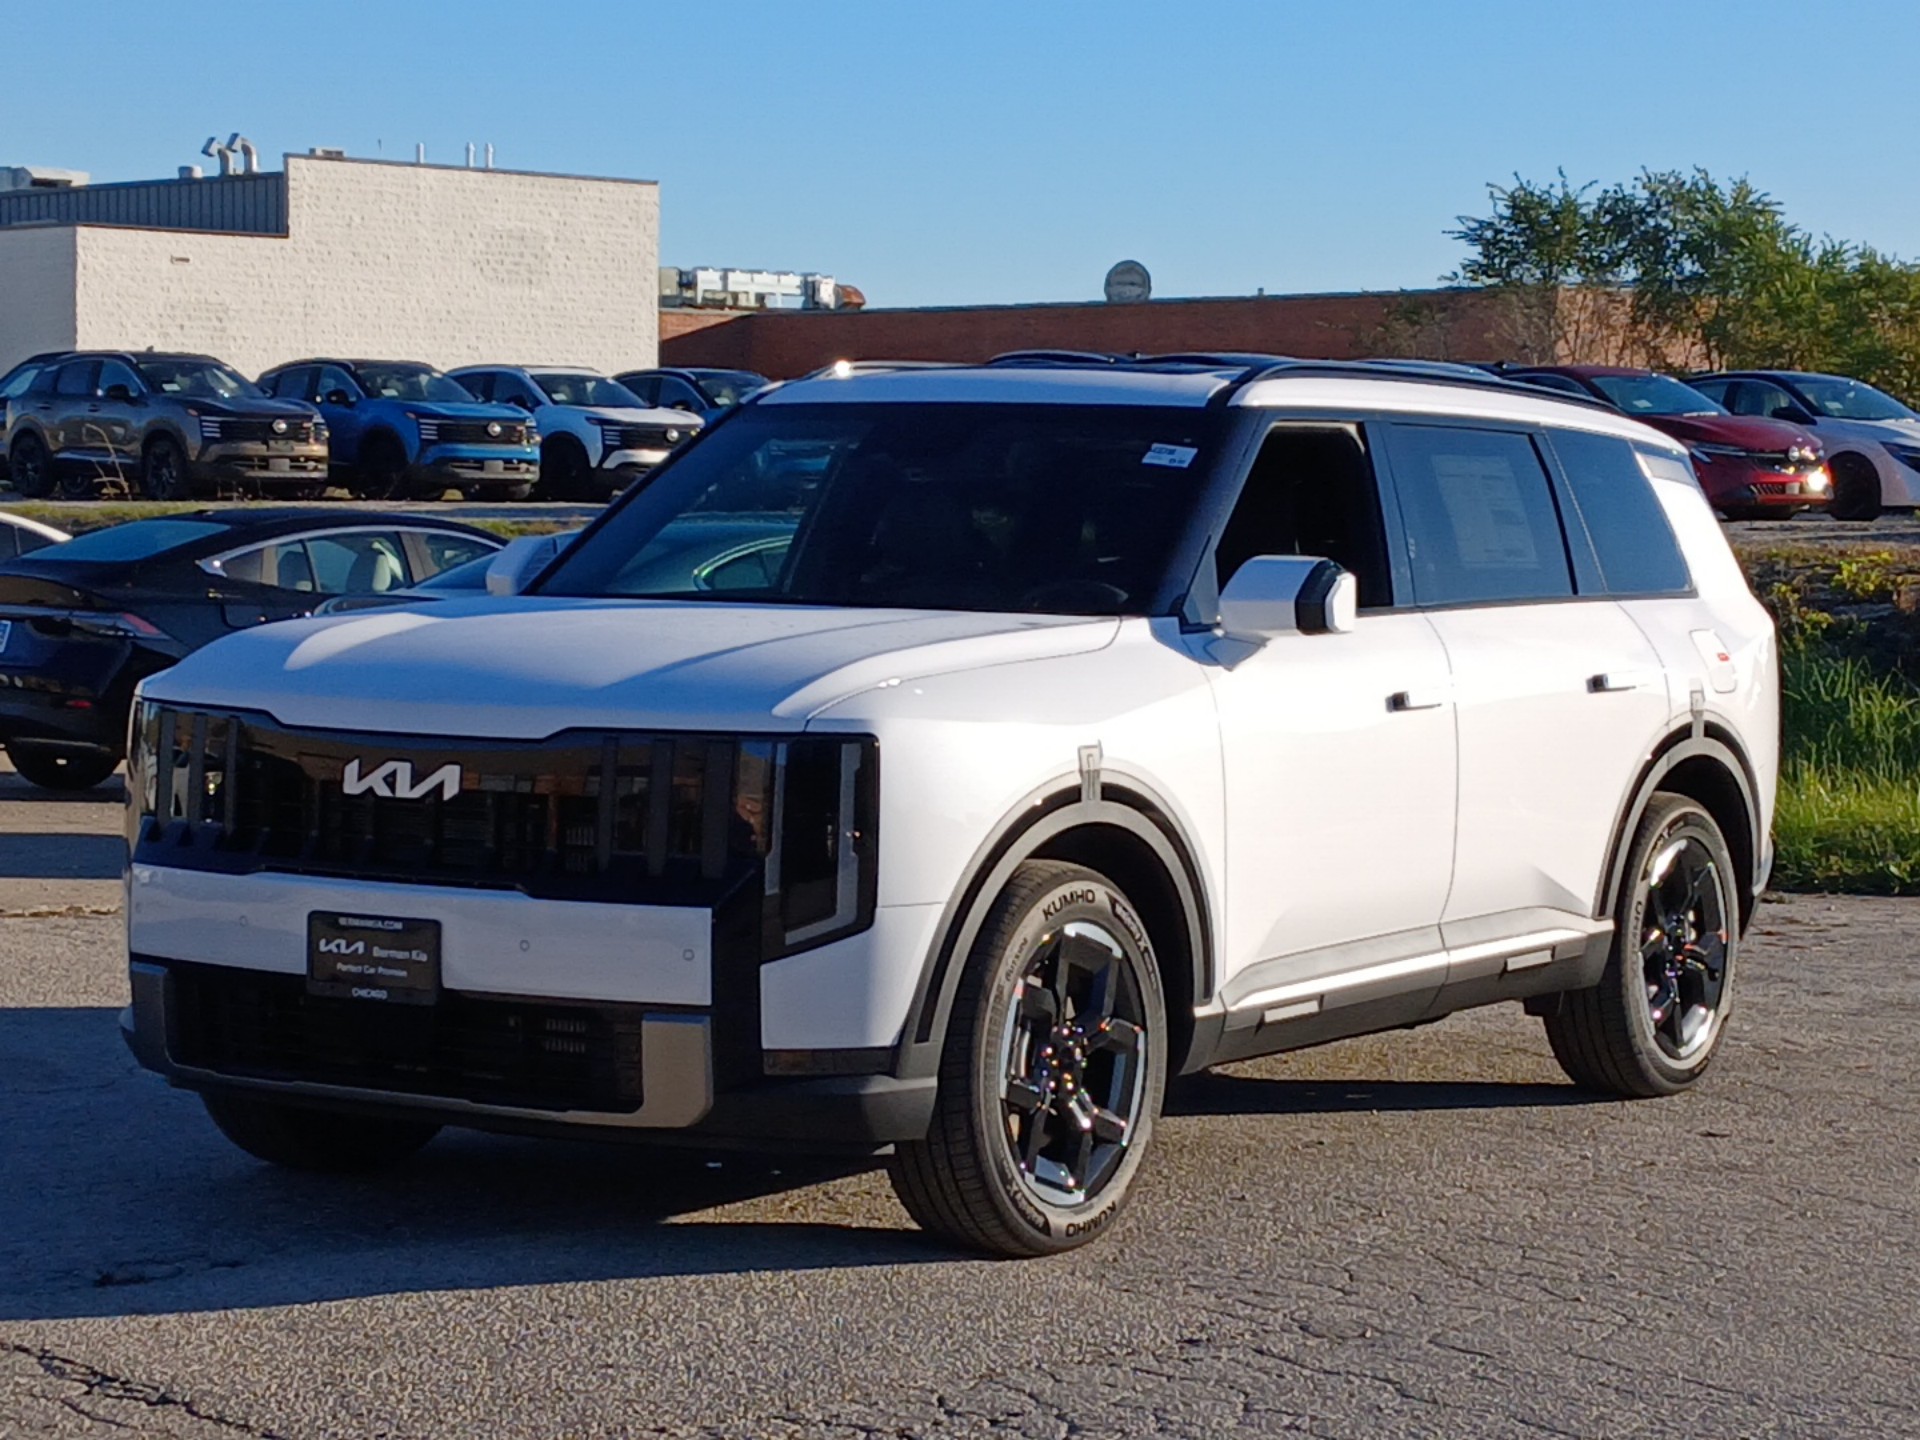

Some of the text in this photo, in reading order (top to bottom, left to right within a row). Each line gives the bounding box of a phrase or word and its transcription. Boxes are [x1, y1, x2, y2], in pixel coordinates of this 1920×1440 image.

[342, 758, 461, 801] KIA
[1042, 888, 1096, 921] KUMHO
[319, 938, 365, 955] KIA
[1065, 1201, 1117, 1238] KUMHO
